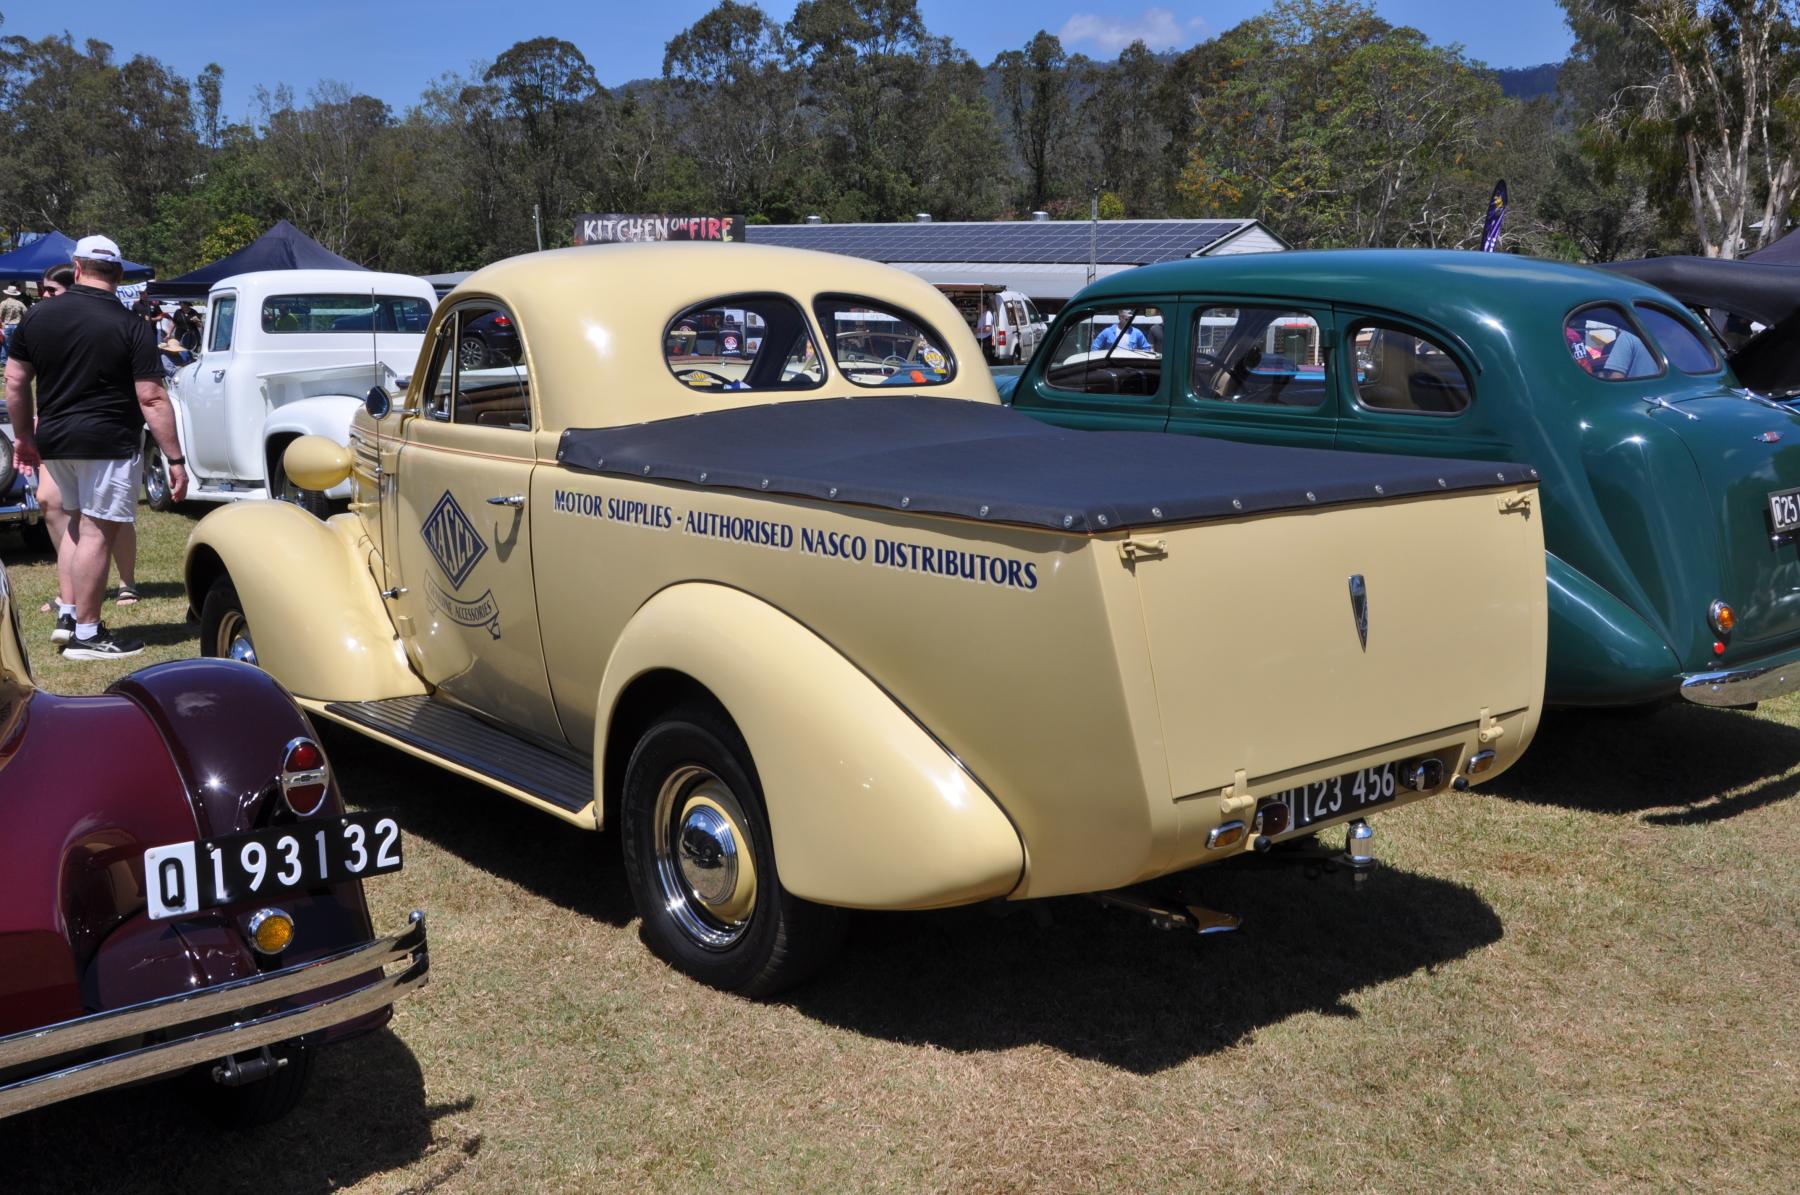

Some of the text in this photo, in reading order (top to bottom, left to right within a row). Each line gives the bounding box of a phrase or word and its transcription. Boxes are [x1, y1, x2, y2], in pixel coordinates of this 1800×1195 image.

[583, 216, 733, 242] KITCHEN ON FIRE
[429, 503, 474, 575] NASCO
[554, 489, 602, 518] MOTOR
[607, 498, 673, 529] SUPPLIES
[685, 510, 794, 549] AUTHORISED
[800, 527, 867, 561] NASCO
[873, 538, 1038, 590] DISTRIBUTORS
[455, 599, 492, 622] ACCESSORIES
[1302, 763, 1395, 822] 123 456
